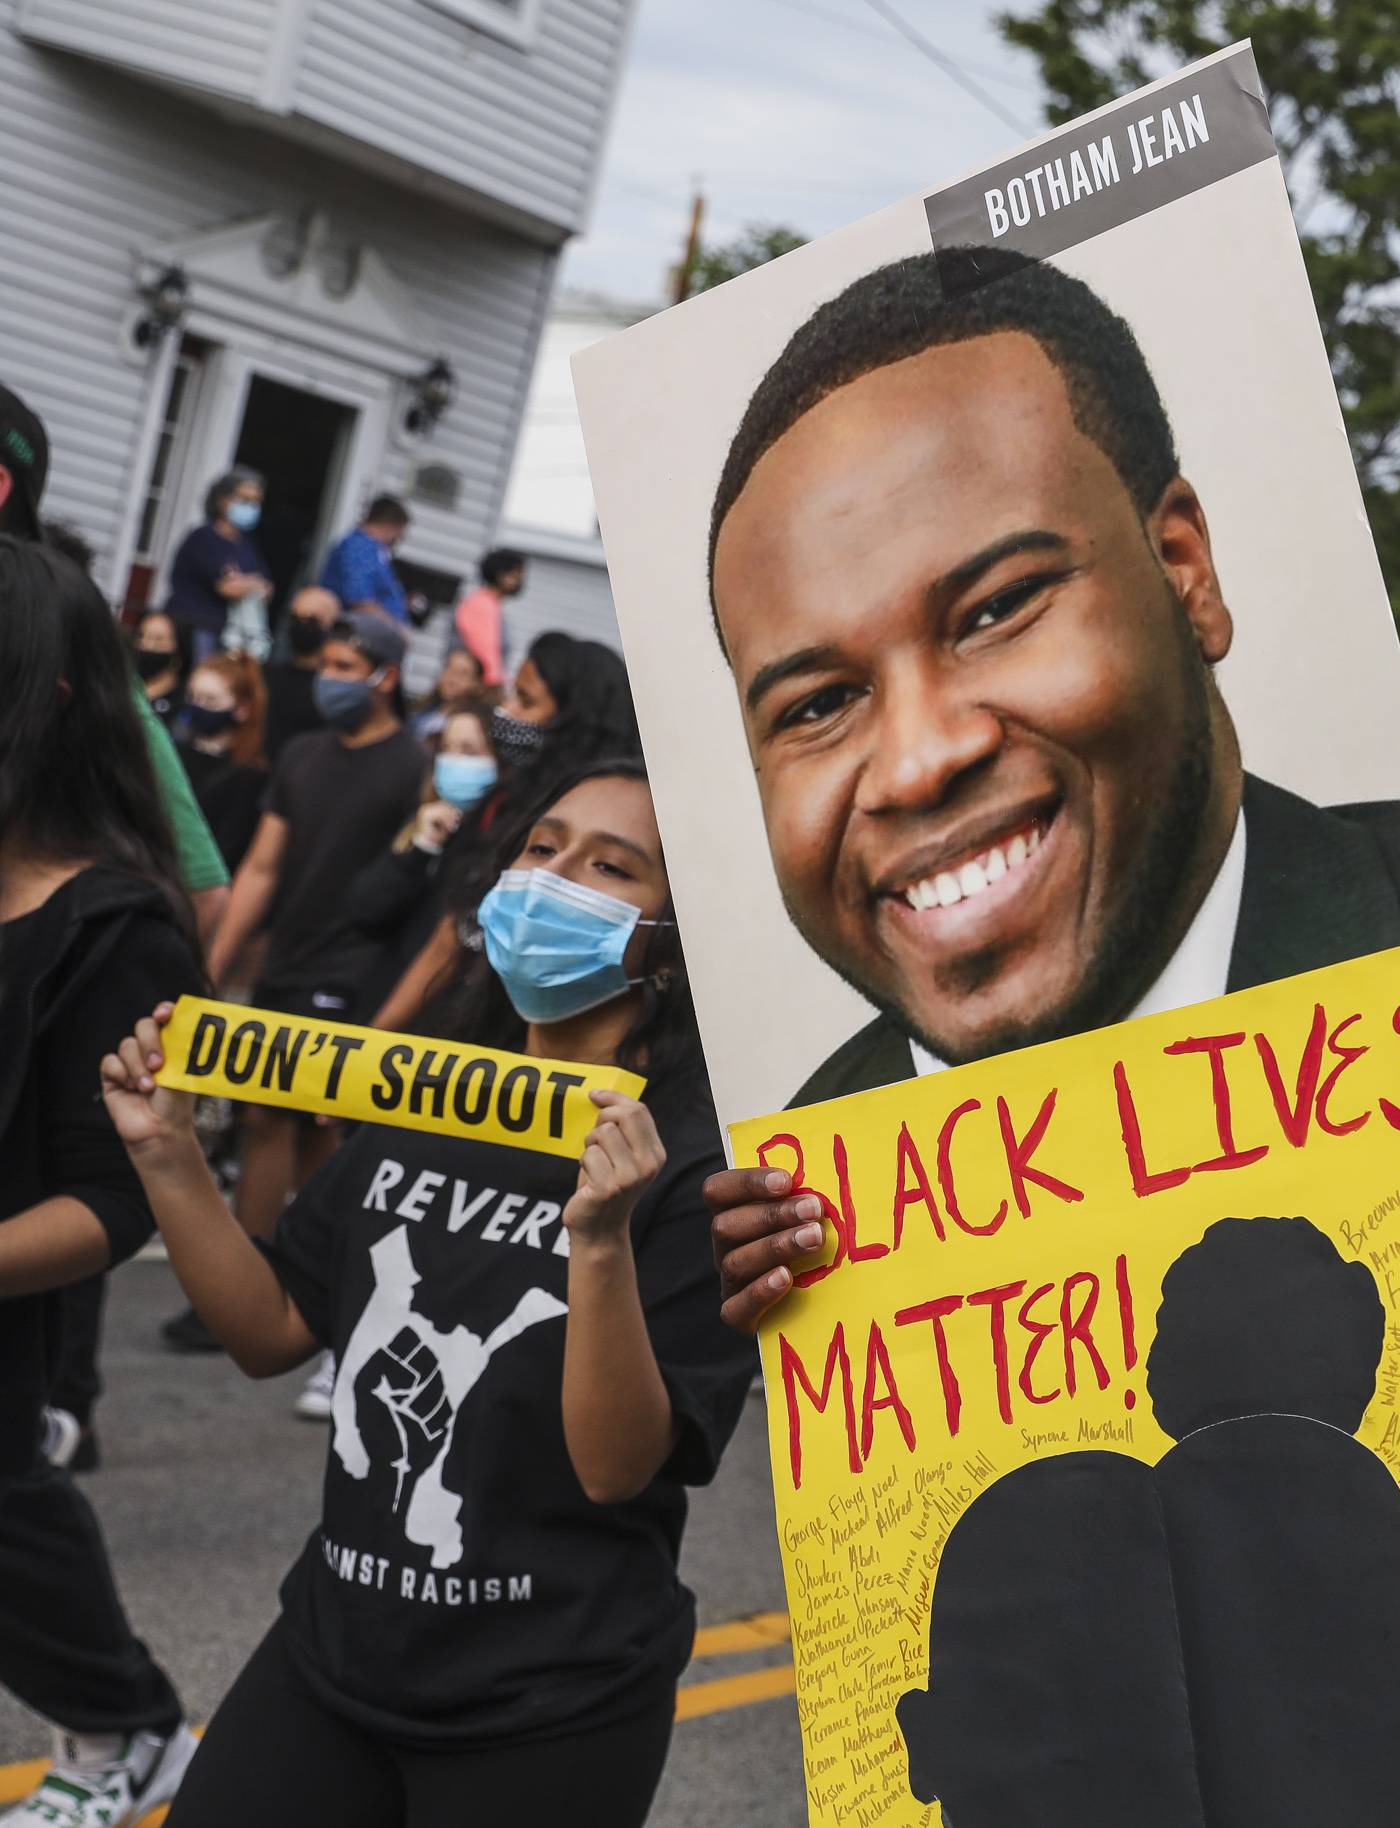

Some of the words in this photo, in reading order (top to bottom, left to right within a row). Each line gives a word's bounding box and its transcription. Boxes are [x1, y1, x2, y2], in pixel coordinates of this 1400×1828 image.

[984, 135, 1120, 239] BOTHAM
[1127, 94, 1210, 175] JEAN
[185, 1013, 364, 1100] DON'T
[370, 1044, 586, 1139] SHOOT
[757, 1087, 1084, 1289] BLACK
[778, 1254, 1138, 1490] MATTER!
[1377, 1354, 1400, 1406] Walter
[1077, 1417, 1134, 1443] Marshall
[871, 1465, 900, 1508] Noel
[876, 1491, 914, 1538] Alfred
[914, 1461, 953, 1494] Olango
[934, 1485, 972, 1527] Miles
[963, 1450, 998, 1486] Hall
[784, 1517, 828, 1552] George
[829, 1486, 867, 1521] Floyd
[897, 1550, 917, 1595] Mario
[911, 1489, 934, 1541] Woods
[400, 1566, 532, 1606] RACISM
[848, 1545, 880, 1572] Abdi
[794, 1609, 849, 1648] Kendrick
[853, 1593, 900, 1636] Johnson
[806, 1585, 850, 1621] James
[855, 1571, 896, 1595] Perez
[905, 1569, 931, 1635] Miguel
[799, 1626, 858, 1666] Nathaniel
[865, 1607, 906, 1640] Pickett
[857, 1652, 896, 1683] Tamir
[899, 1638, 924, 1665] Rice
[797, 1661, 838, 1692] Gregory
[838, 1678, 866, 1703] Clark
[868, 1664, 902, 1703] Jordan
[855, 1691, 901, 1725] Franklin
[805, 1755, 838, 1781] Kevin
[842, 1718, 893, 1759] Matthews
[808, 1782, 848, 1819] Yassin
[850, 1731, 903, 1784] Mohamed
[833, 1784, 878, 1826] Kwame
[879, 1758, 907, 1789] Jones
